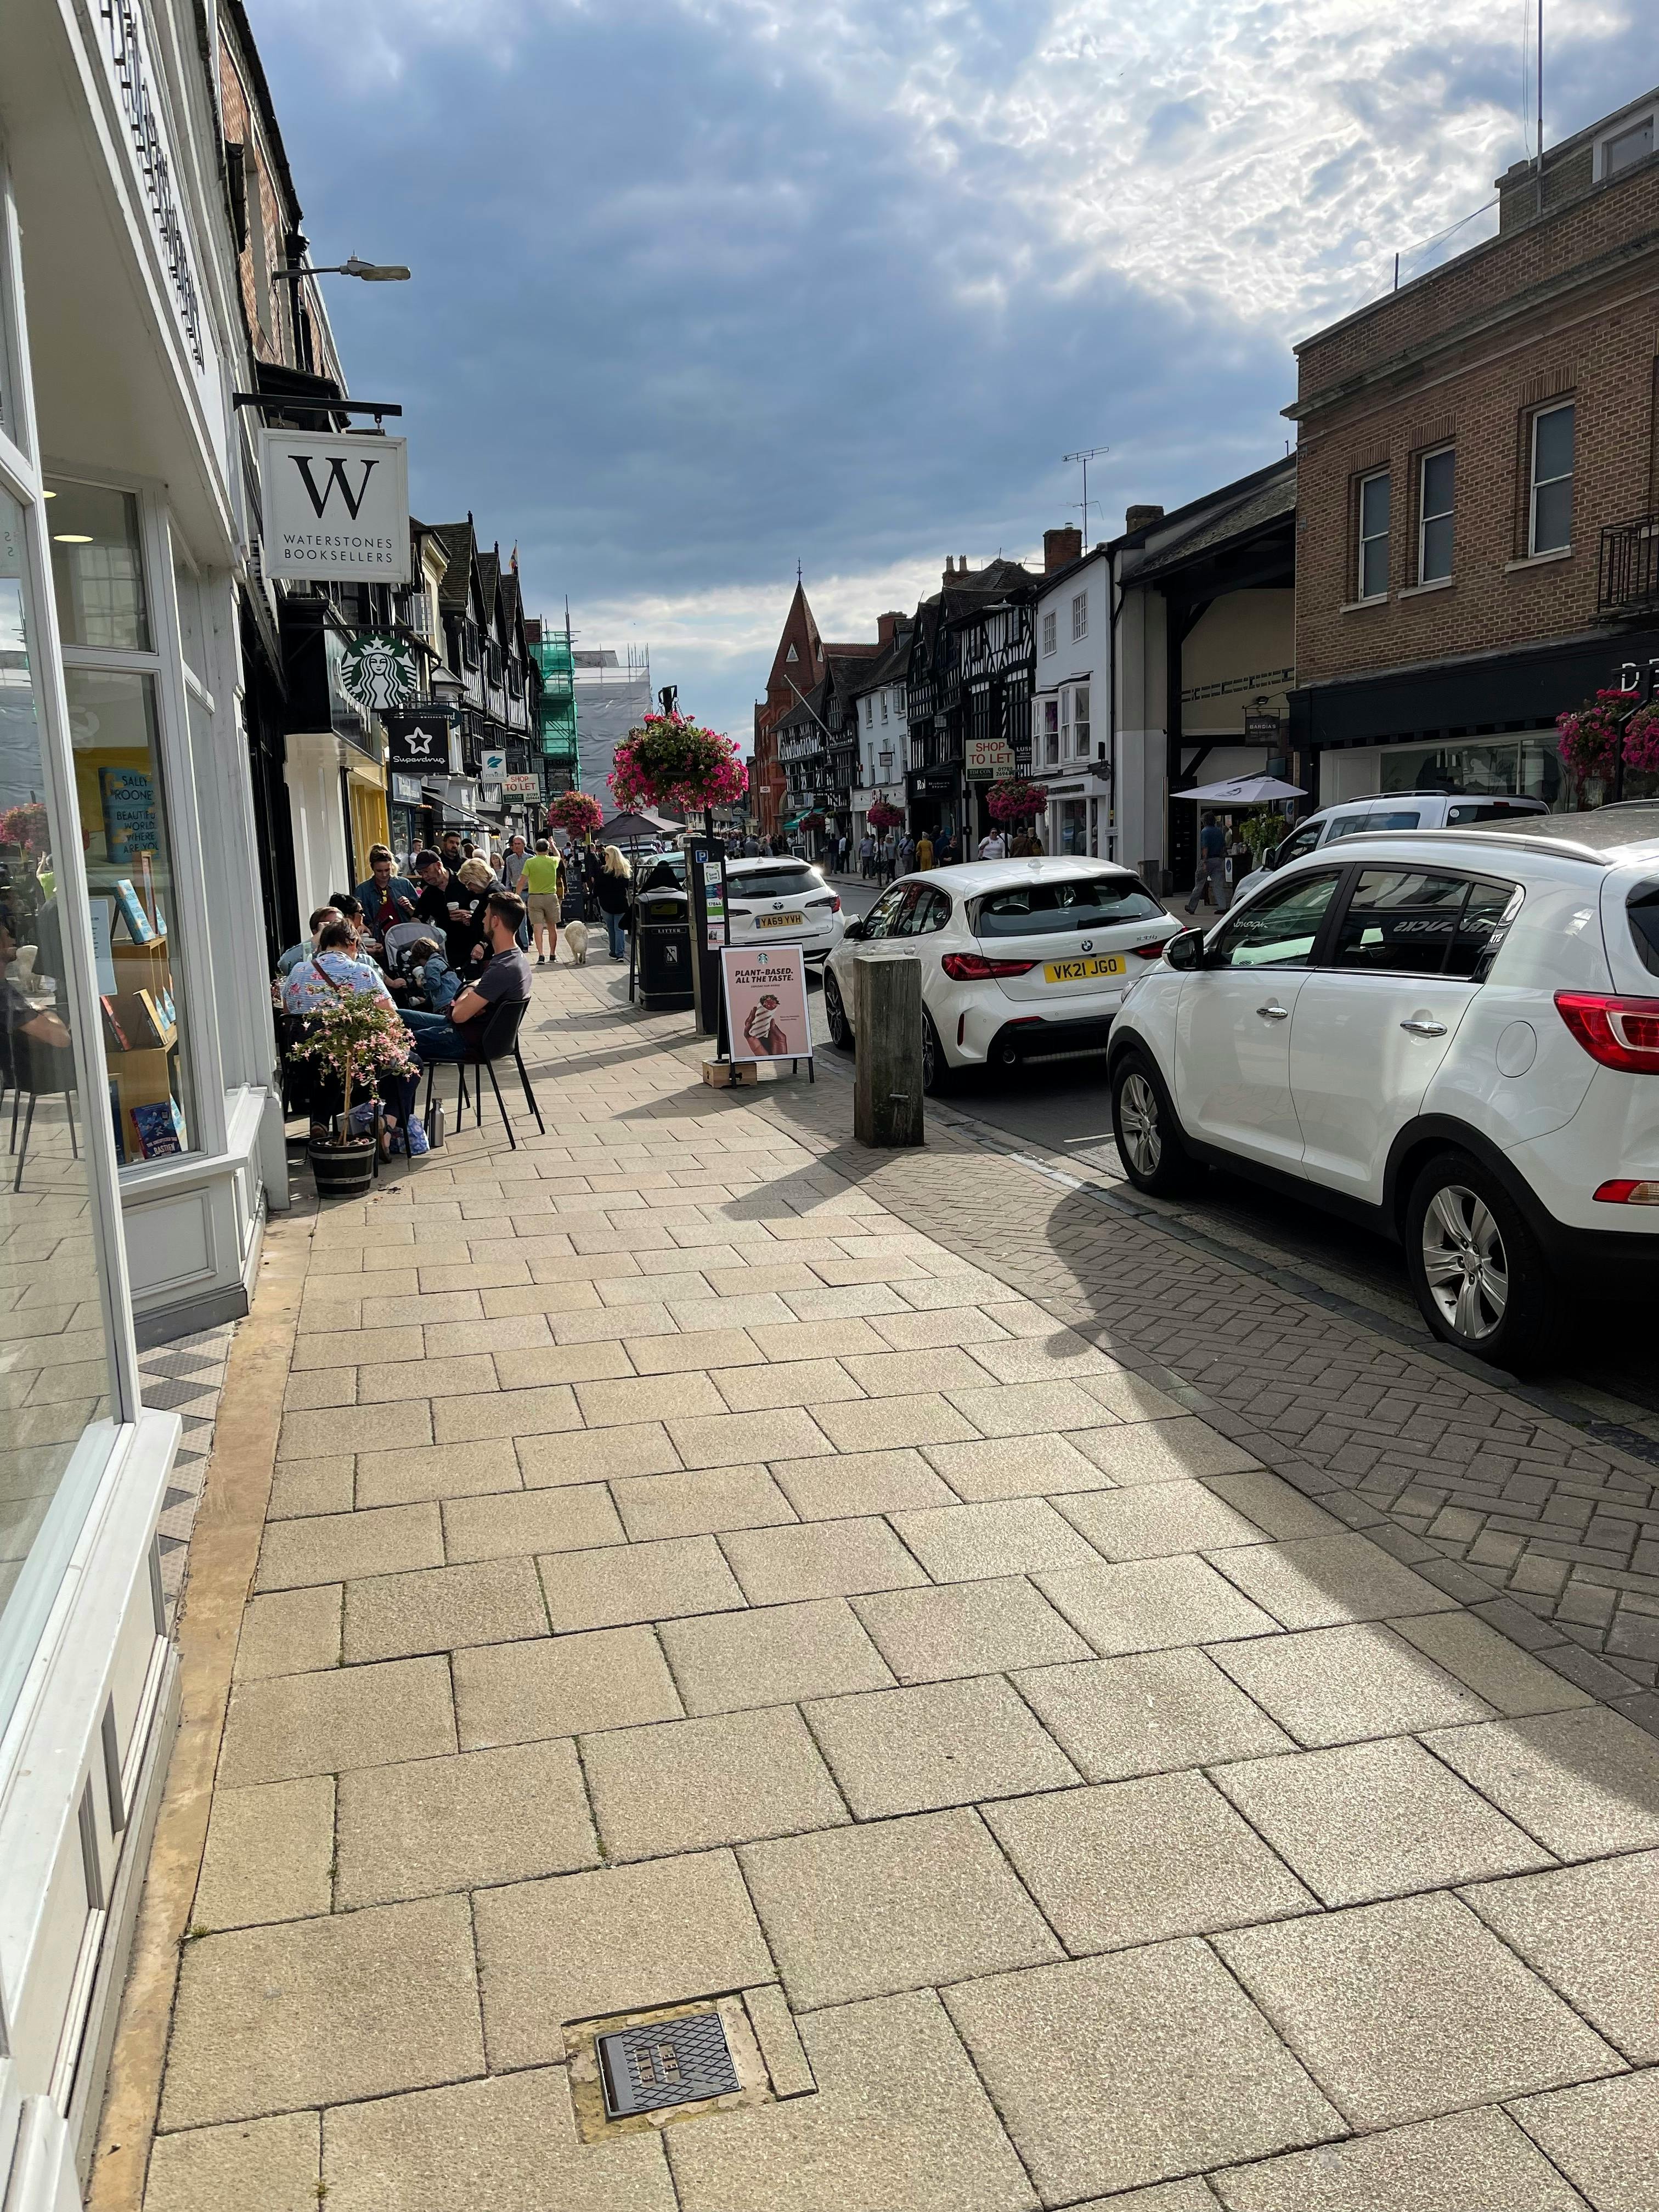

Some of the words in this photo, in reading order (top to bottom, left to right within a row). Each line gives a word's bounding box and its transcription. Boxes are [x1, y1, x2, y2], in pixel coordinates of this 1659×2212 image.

[288, 455, 379, 521] W
[284, 534, 392, 549] WATERSTONES
[285, 549, 392, 563] BOOKSELLERS
[975, 742, 1005, 752] SHOP
[393, 756, 446, 764] Superdrug
[969, 754, 985, 765] TO
[990, 753, 1012, 764] LET
[122, 776, 148, 787] SALLY
[520, 782, 536, 791] LET
[115, 789, 154, 800] ROONE
[117, 811, 156, 820] BEAUTIFU
[699, 851, 706, 861] P
[761, 917, 783, 927] YA69
[785, 915, 801, 924] YVH
[735, 968, 793, 977] PLANT-BASED.
[1053, 962, 1086, 979] VK21
[1091, 958, 1118, 975] JGO
